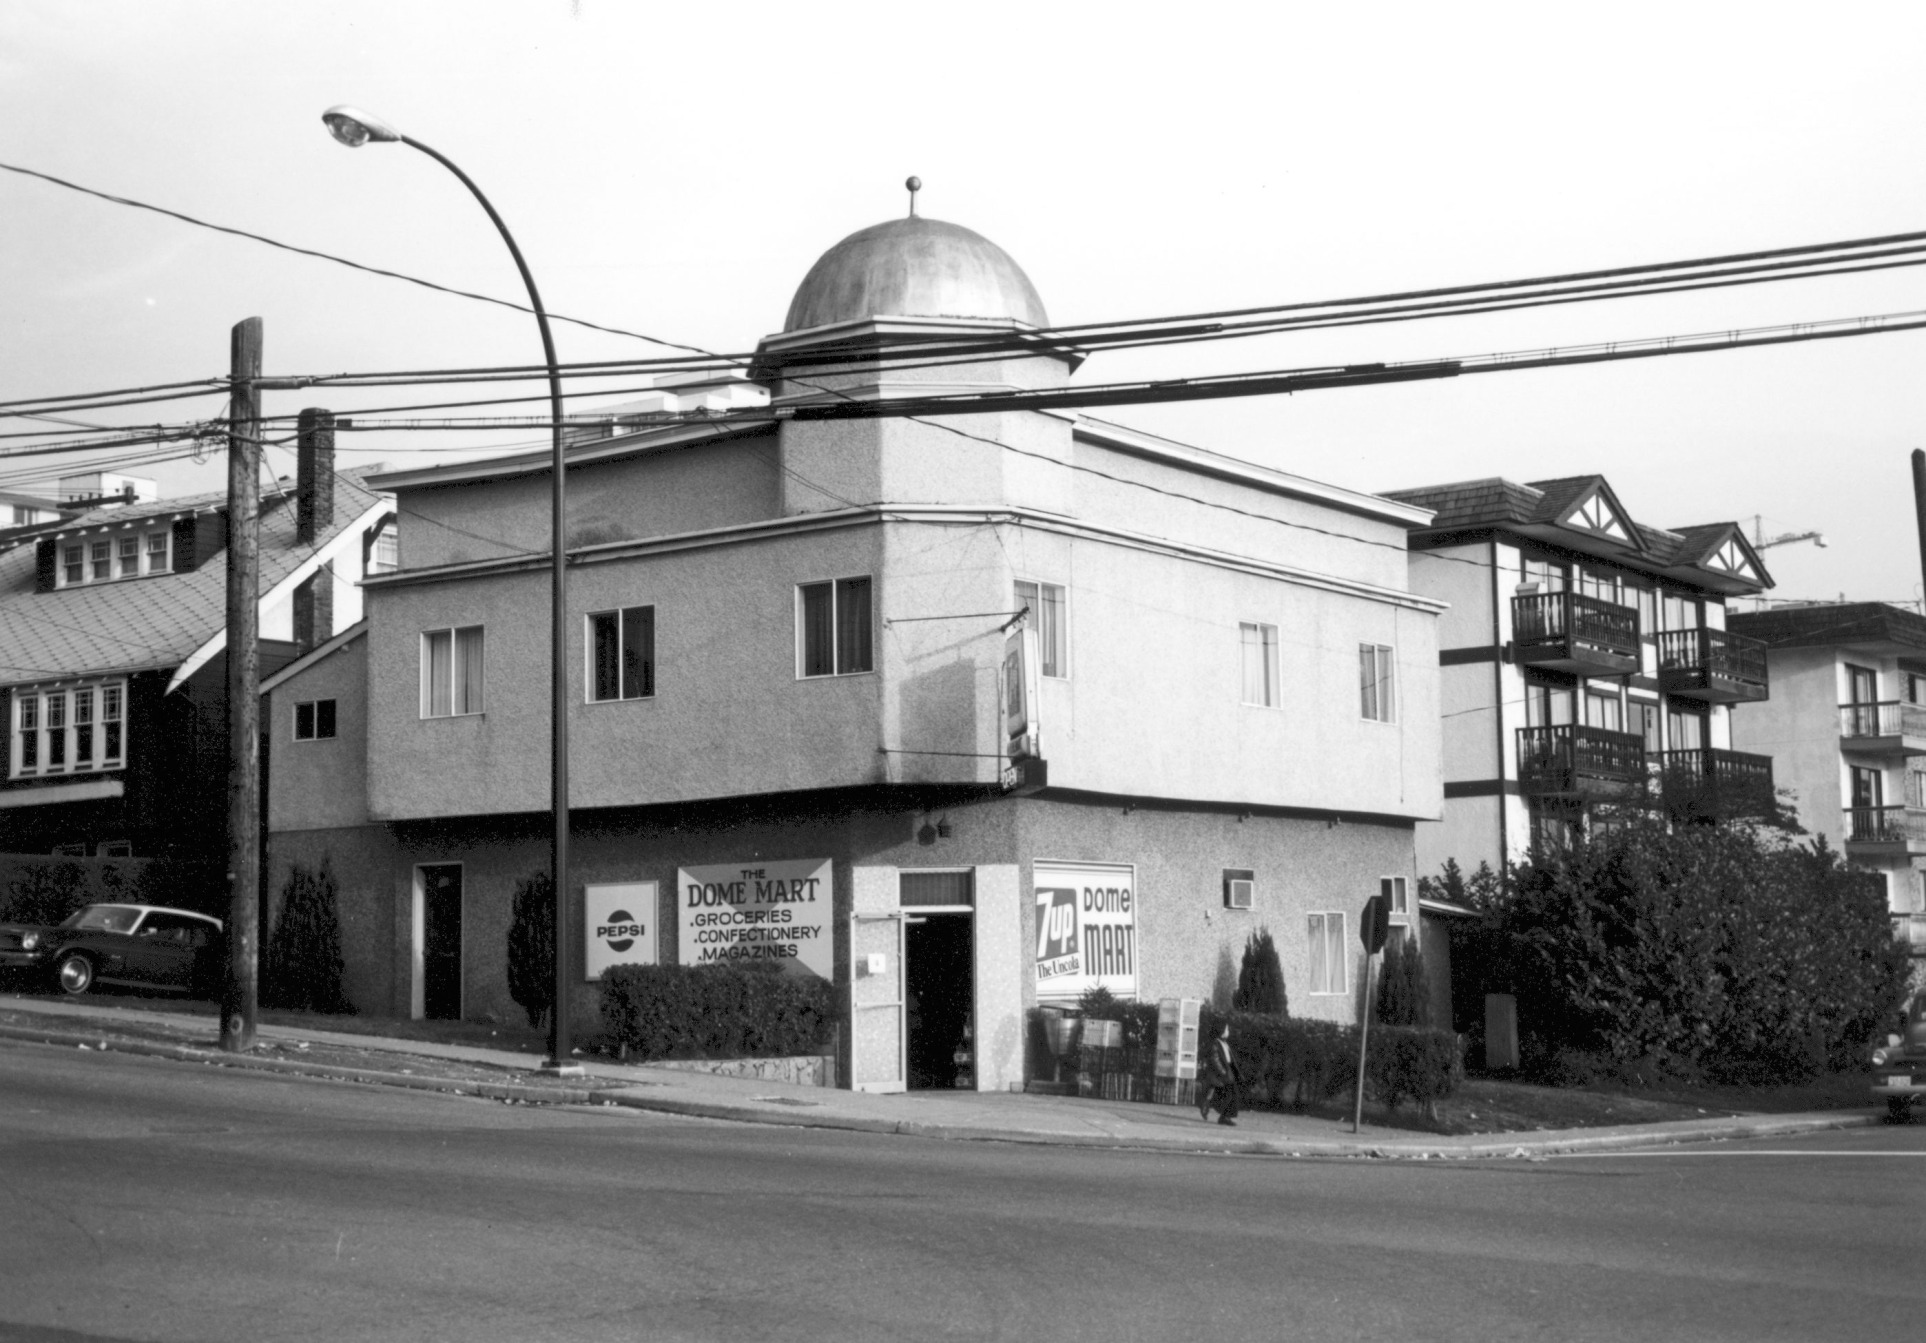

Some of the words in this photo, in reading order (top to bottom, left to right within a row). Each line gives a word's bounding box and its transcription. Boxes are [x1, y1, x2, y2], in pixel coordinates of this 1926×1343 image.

[741, 869, 766, 880] THE
[687, 881, 747, 908] DOME
[754, 878, 820, 904] MART
[596, 924, 645, 938] PEPSI
[1037, 963, 1052, 979] The
